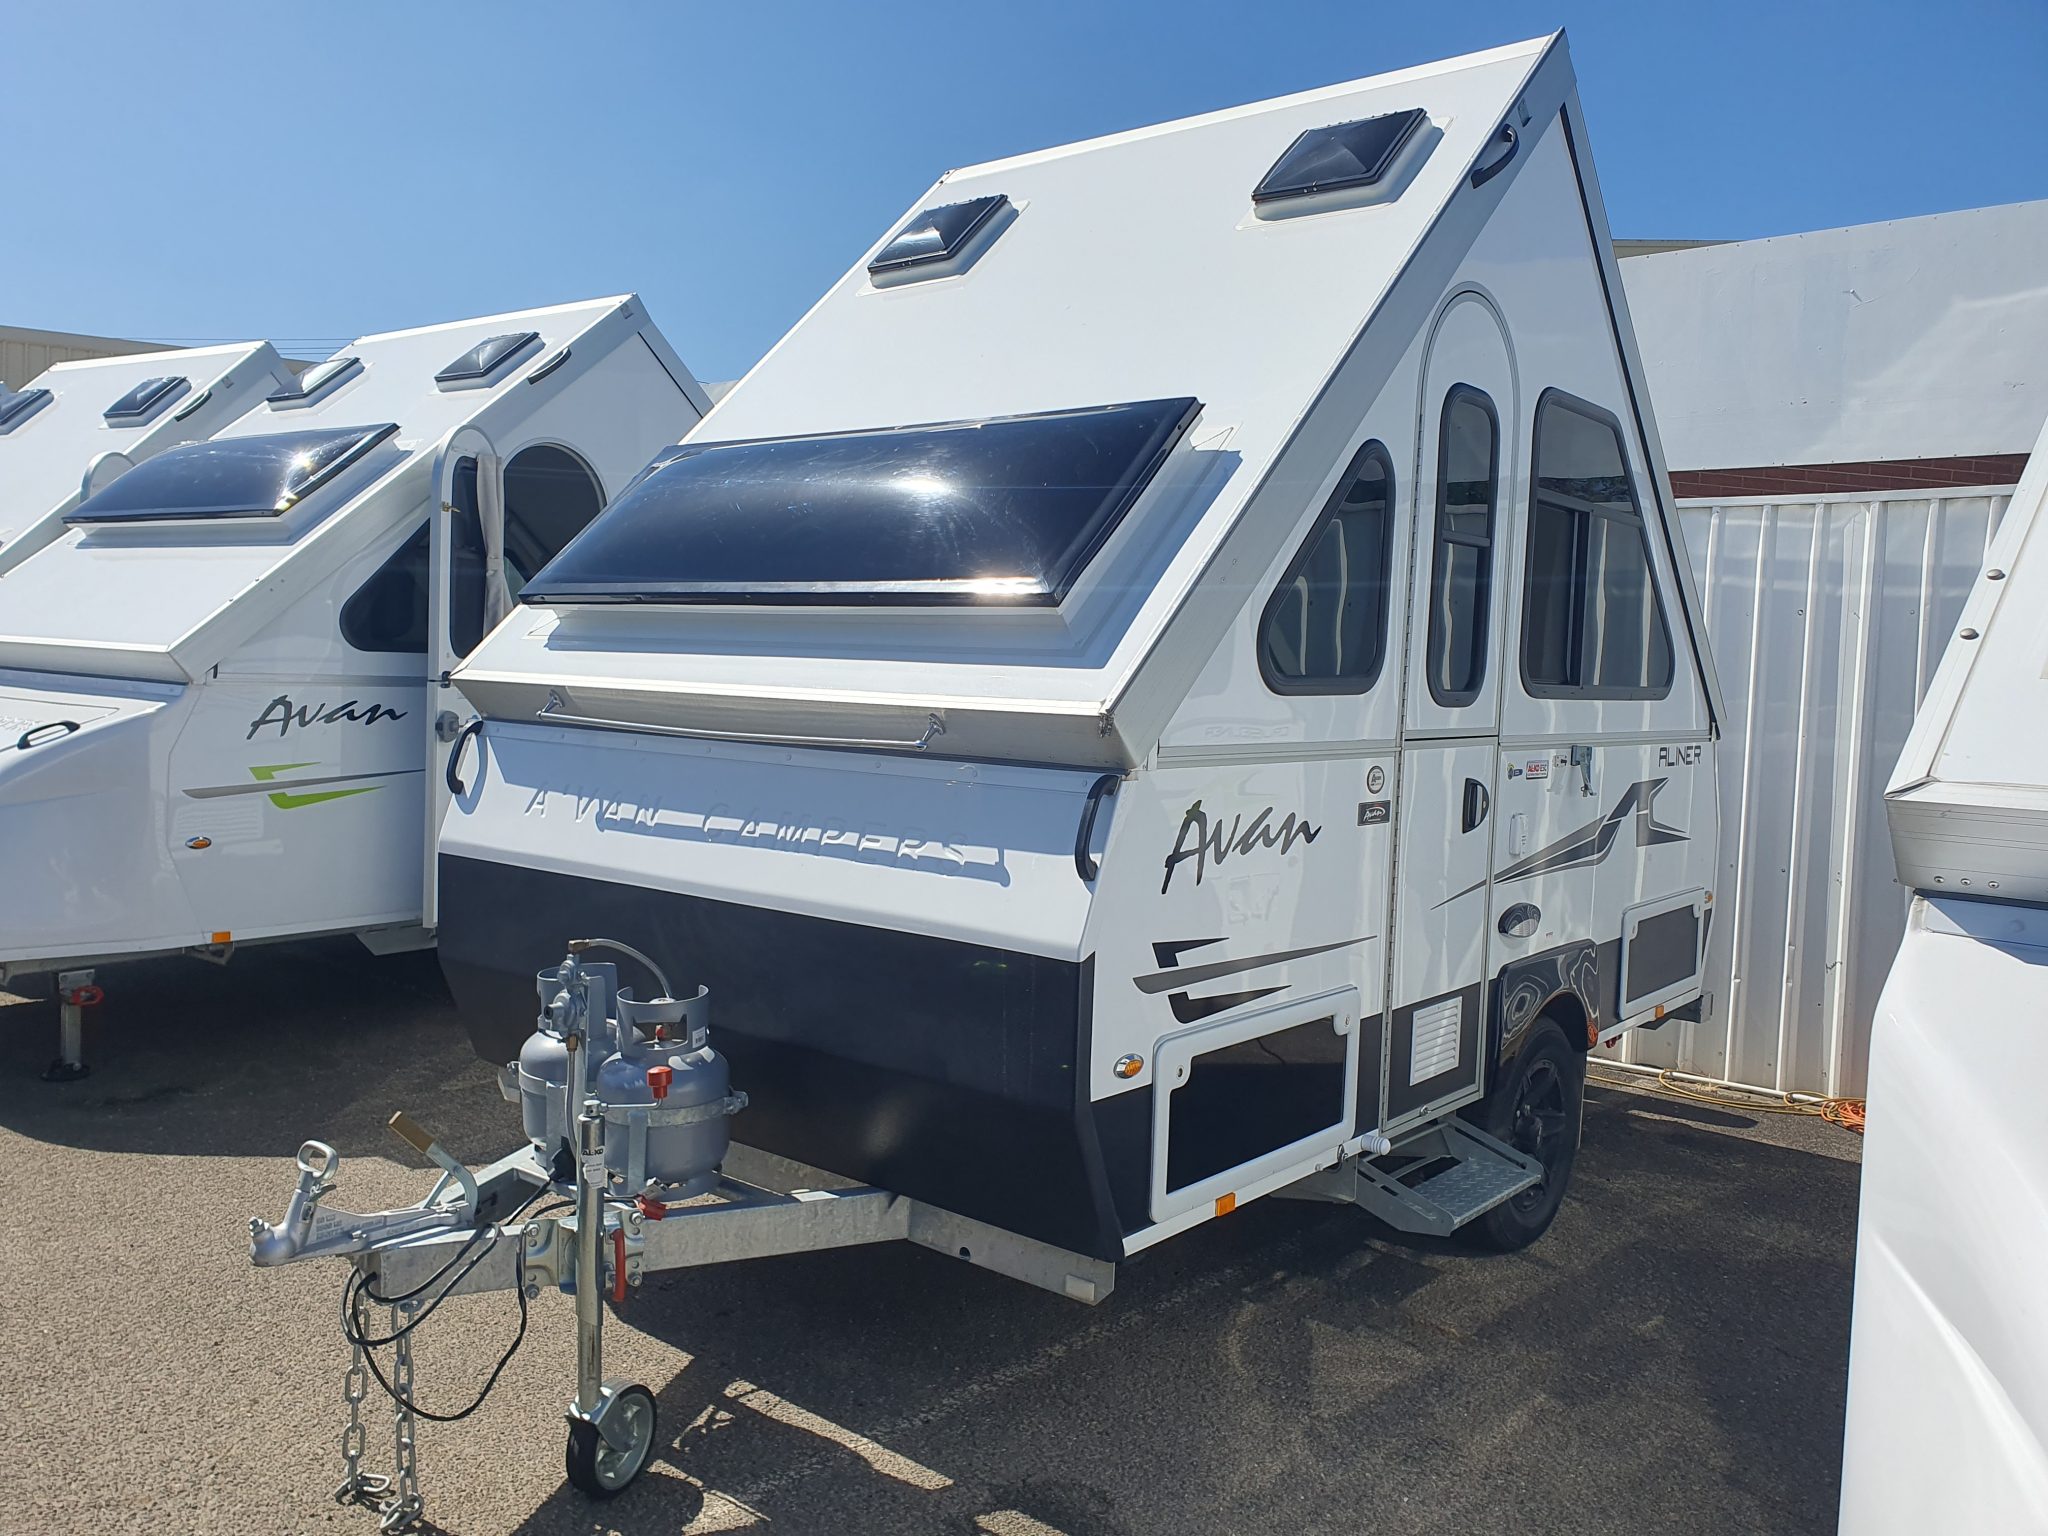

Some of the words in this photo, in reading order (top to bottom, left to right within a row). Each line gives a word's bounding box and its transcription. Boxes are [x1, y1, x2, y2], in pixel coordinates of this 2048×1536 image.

[246, 694, 408, 740] Avan
[1658, 745, 1702, 767] ALINER
[1161, 799, 1322, 895] Avan
